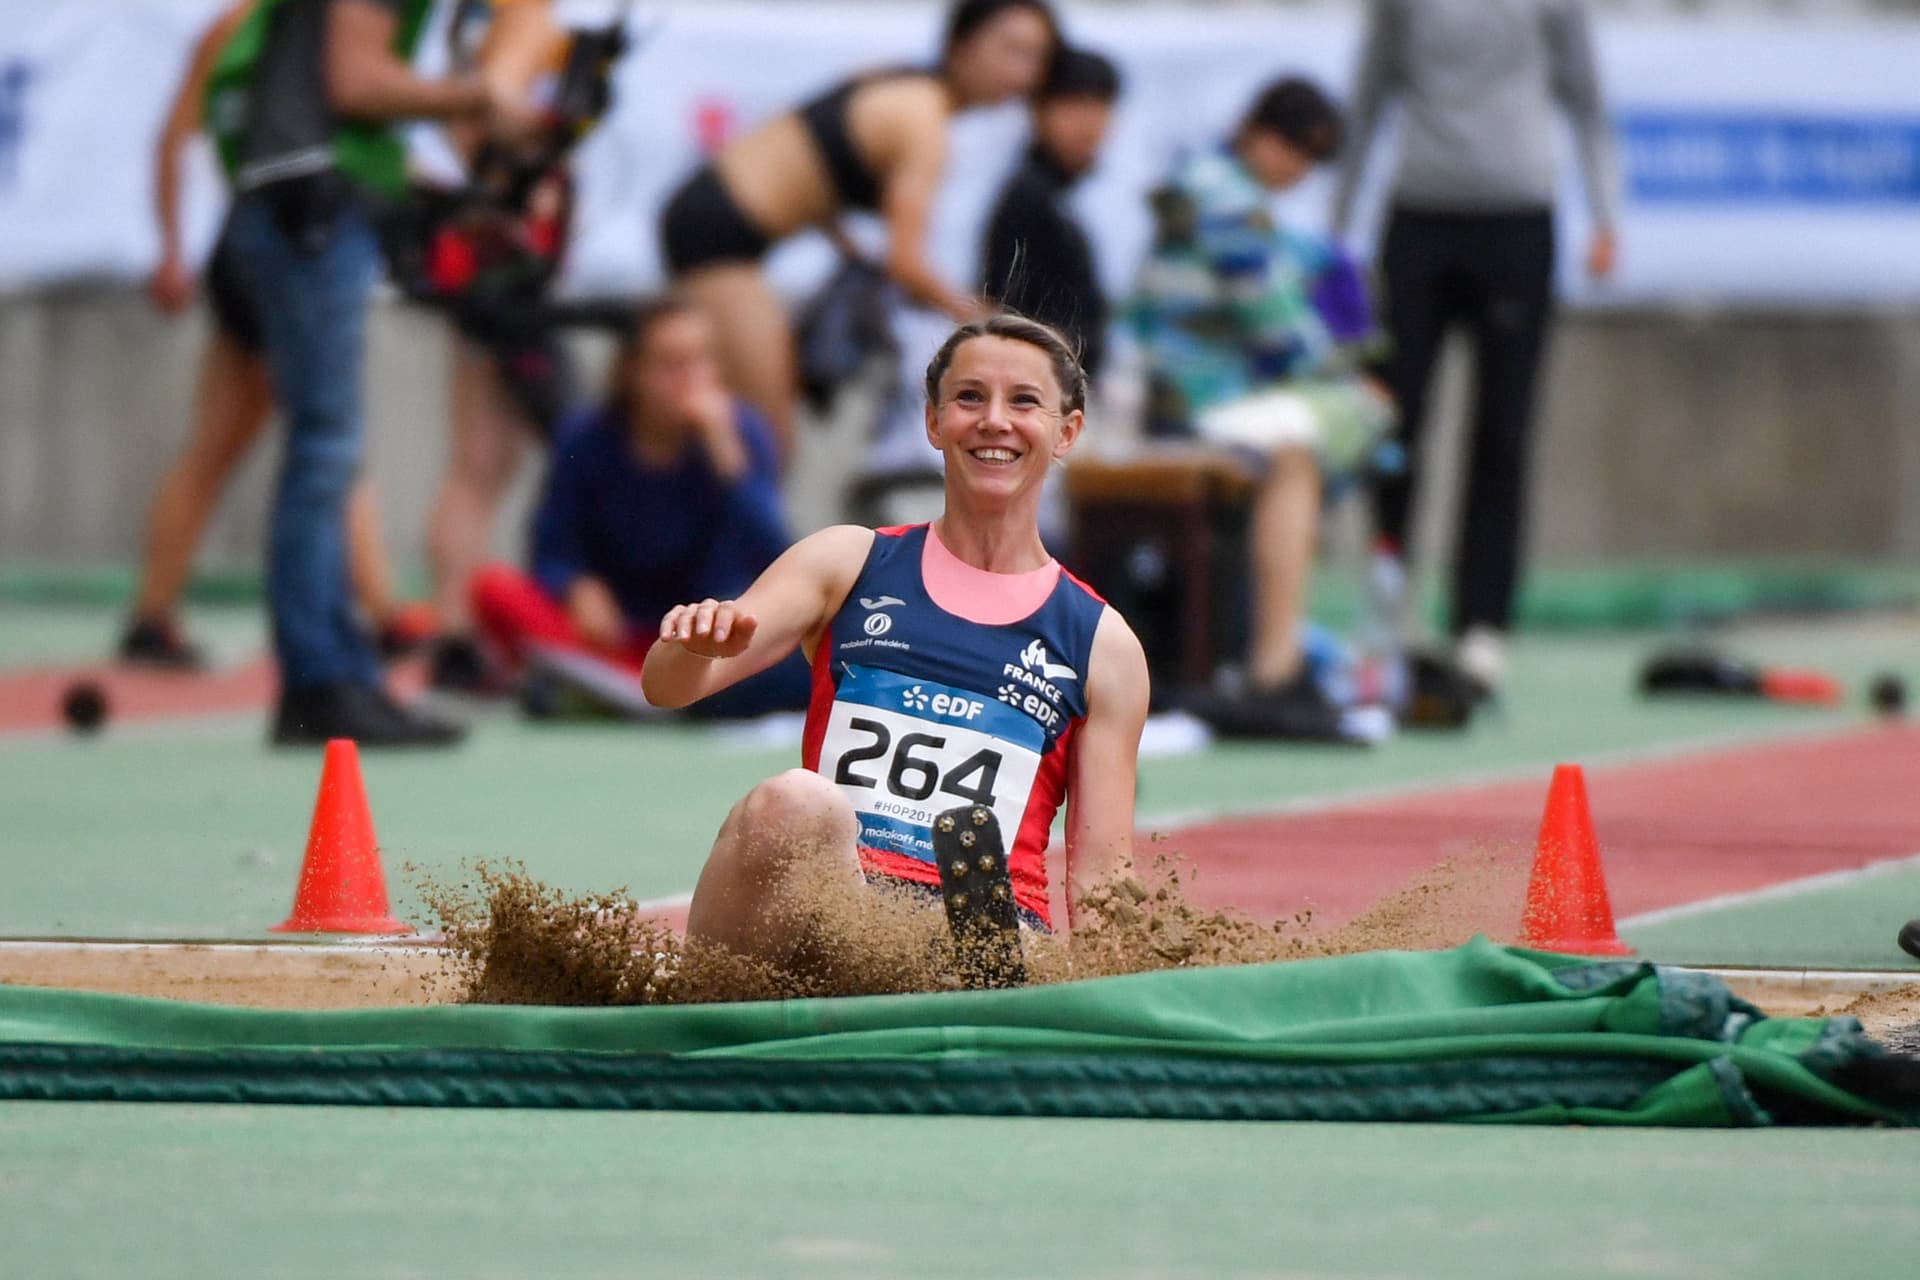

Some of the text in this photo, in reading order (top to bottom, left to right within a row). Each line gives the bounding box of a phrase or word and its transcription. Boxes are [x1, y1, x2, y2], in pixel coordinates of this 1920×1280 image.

[1003, 663, 1063, 703] FRANCE
[835, 717, 1003, 808] 264
[873, 800, 933, 823] #HOP201
[865, 827, 915, 845] malakoff
